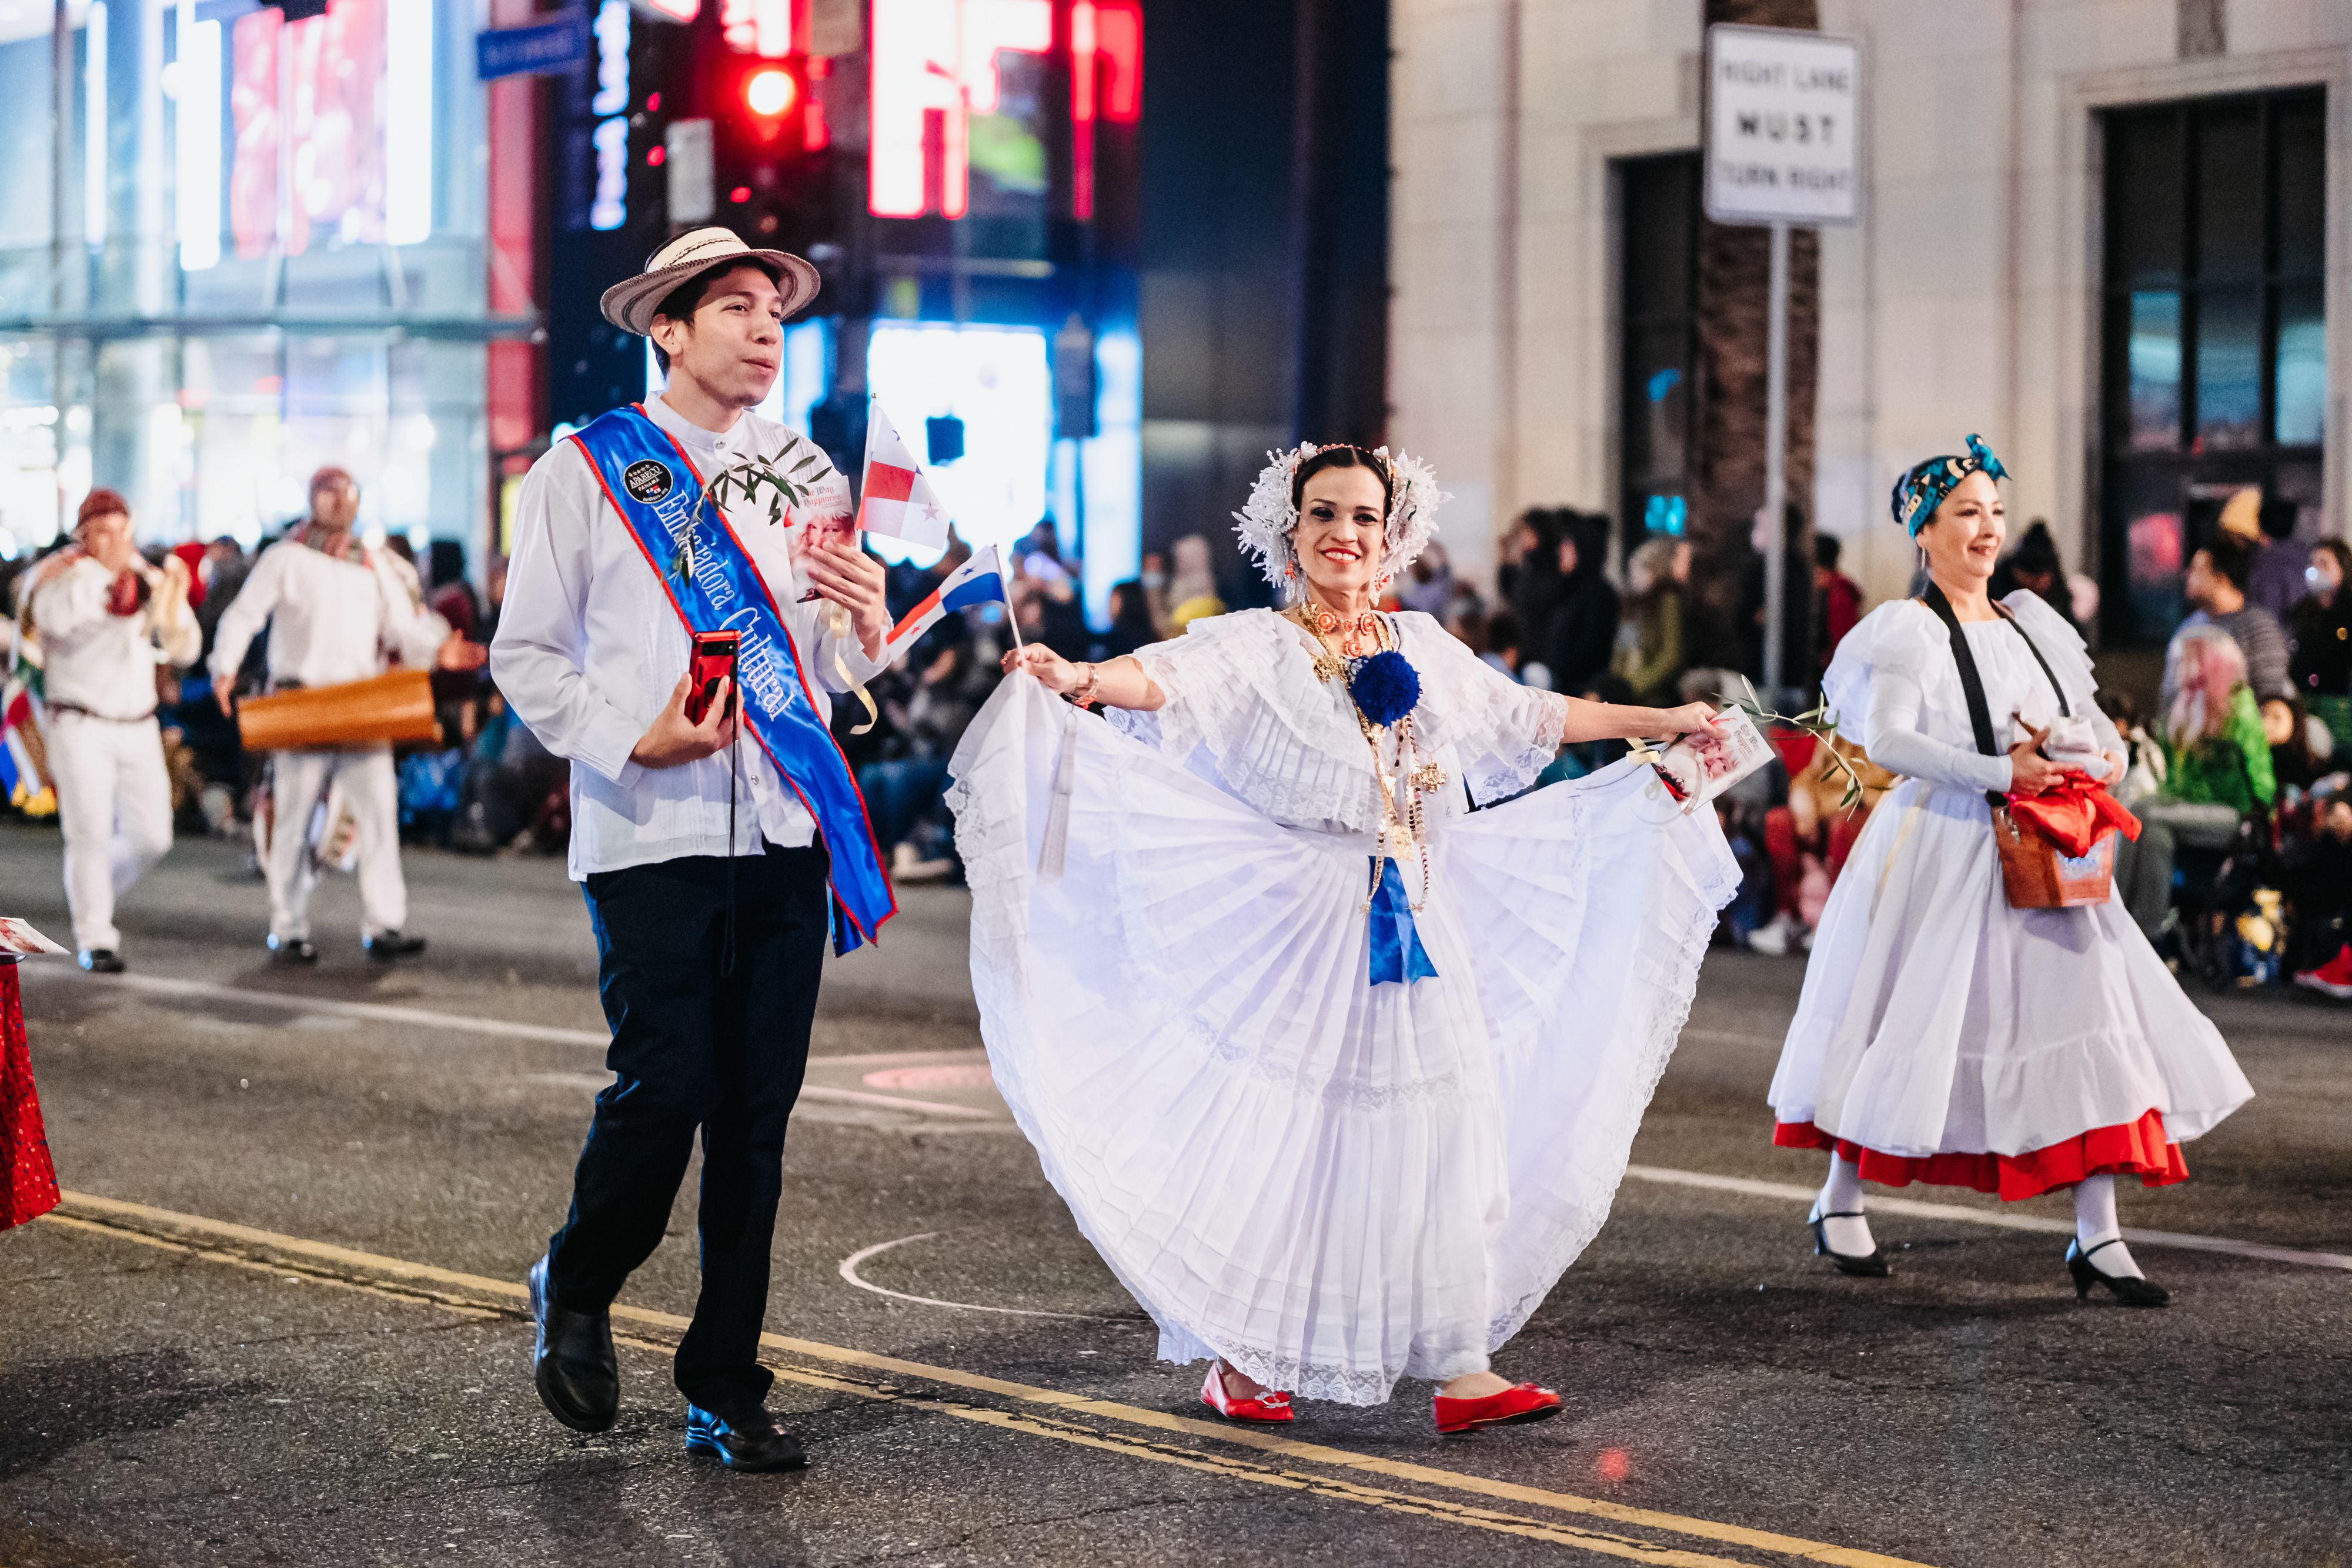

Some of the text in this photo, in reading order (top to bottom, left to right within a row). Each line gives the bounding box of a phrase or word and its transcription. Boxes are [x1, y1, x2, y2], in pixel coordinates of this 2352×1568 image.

[1719, 59, 1849, 92] RIGHT LANE
[1737, 111, 1835, 145] MUST
[1719, 161, 1850, 191] TURN RIGHT
[629, 466, 660, 488] APABECO
[815, 486, 834, 494] Way
[719, 607, 794, 722] Cultural
[1740, 724, 1750, 737] The
